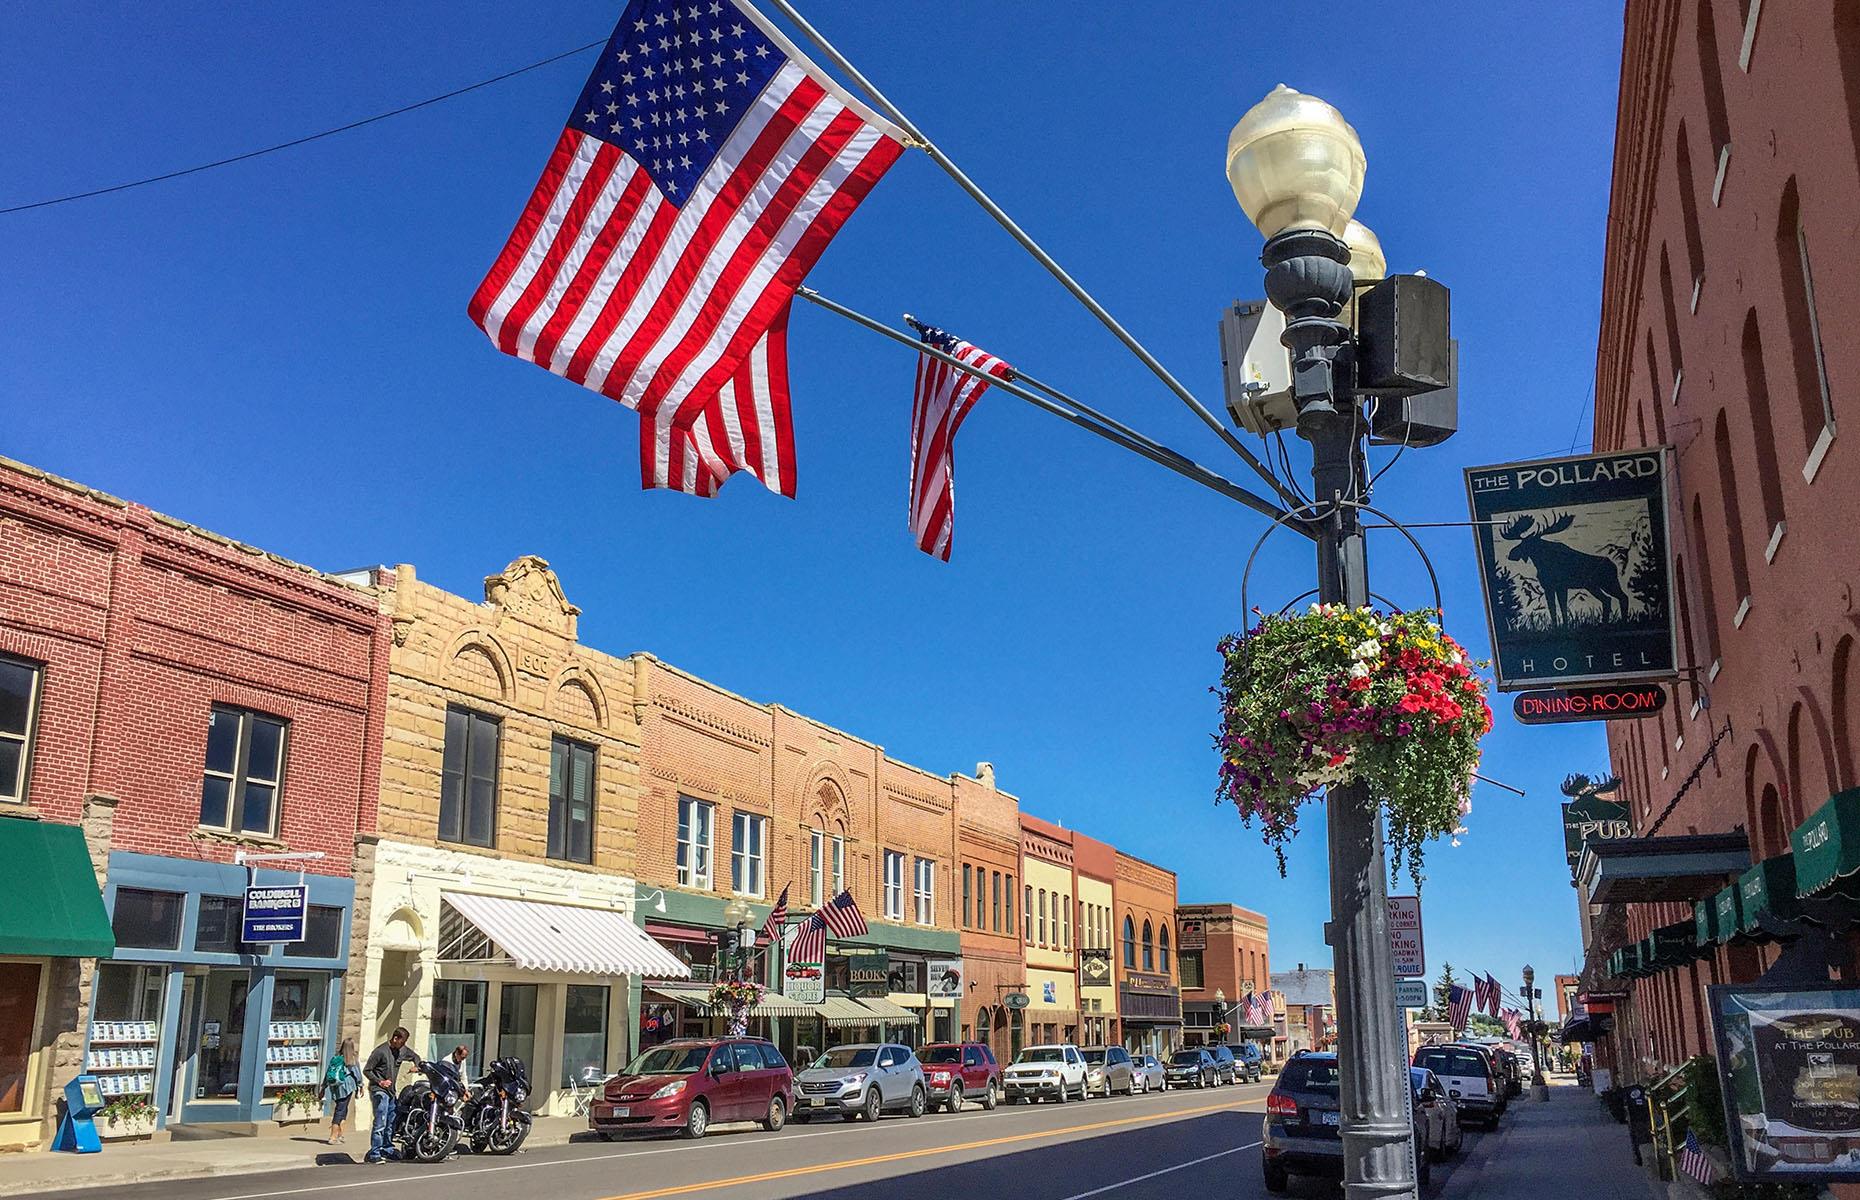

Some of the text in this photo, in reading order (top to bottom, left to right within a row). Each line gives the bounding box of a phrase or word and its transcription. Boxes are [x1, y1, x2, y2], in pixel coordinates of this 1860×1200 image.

[1474, 456, 1658, 489] THE POLLARD
[520, 653, 547, 674] 900
[1522, 654, 1651, 673] HOTEL
[1522, 691, 1656, 715] DINING ROOM
[249, 889, 302, 900] COLDWELL
[249, 900, 292, 910] BANKER
[1393, 949, 1419, 957] OADWAY
[850, 968, 888, 981] BOOKS
[785, 982, 820, 991] LIQUOR
[788, 991, 818, 1000] STORE
[1783, 1027, 1855, 1039] THE PUB
[1774, 1042, 1787, 1050] AT
[1789, 1041, 1814, 1050] THE
